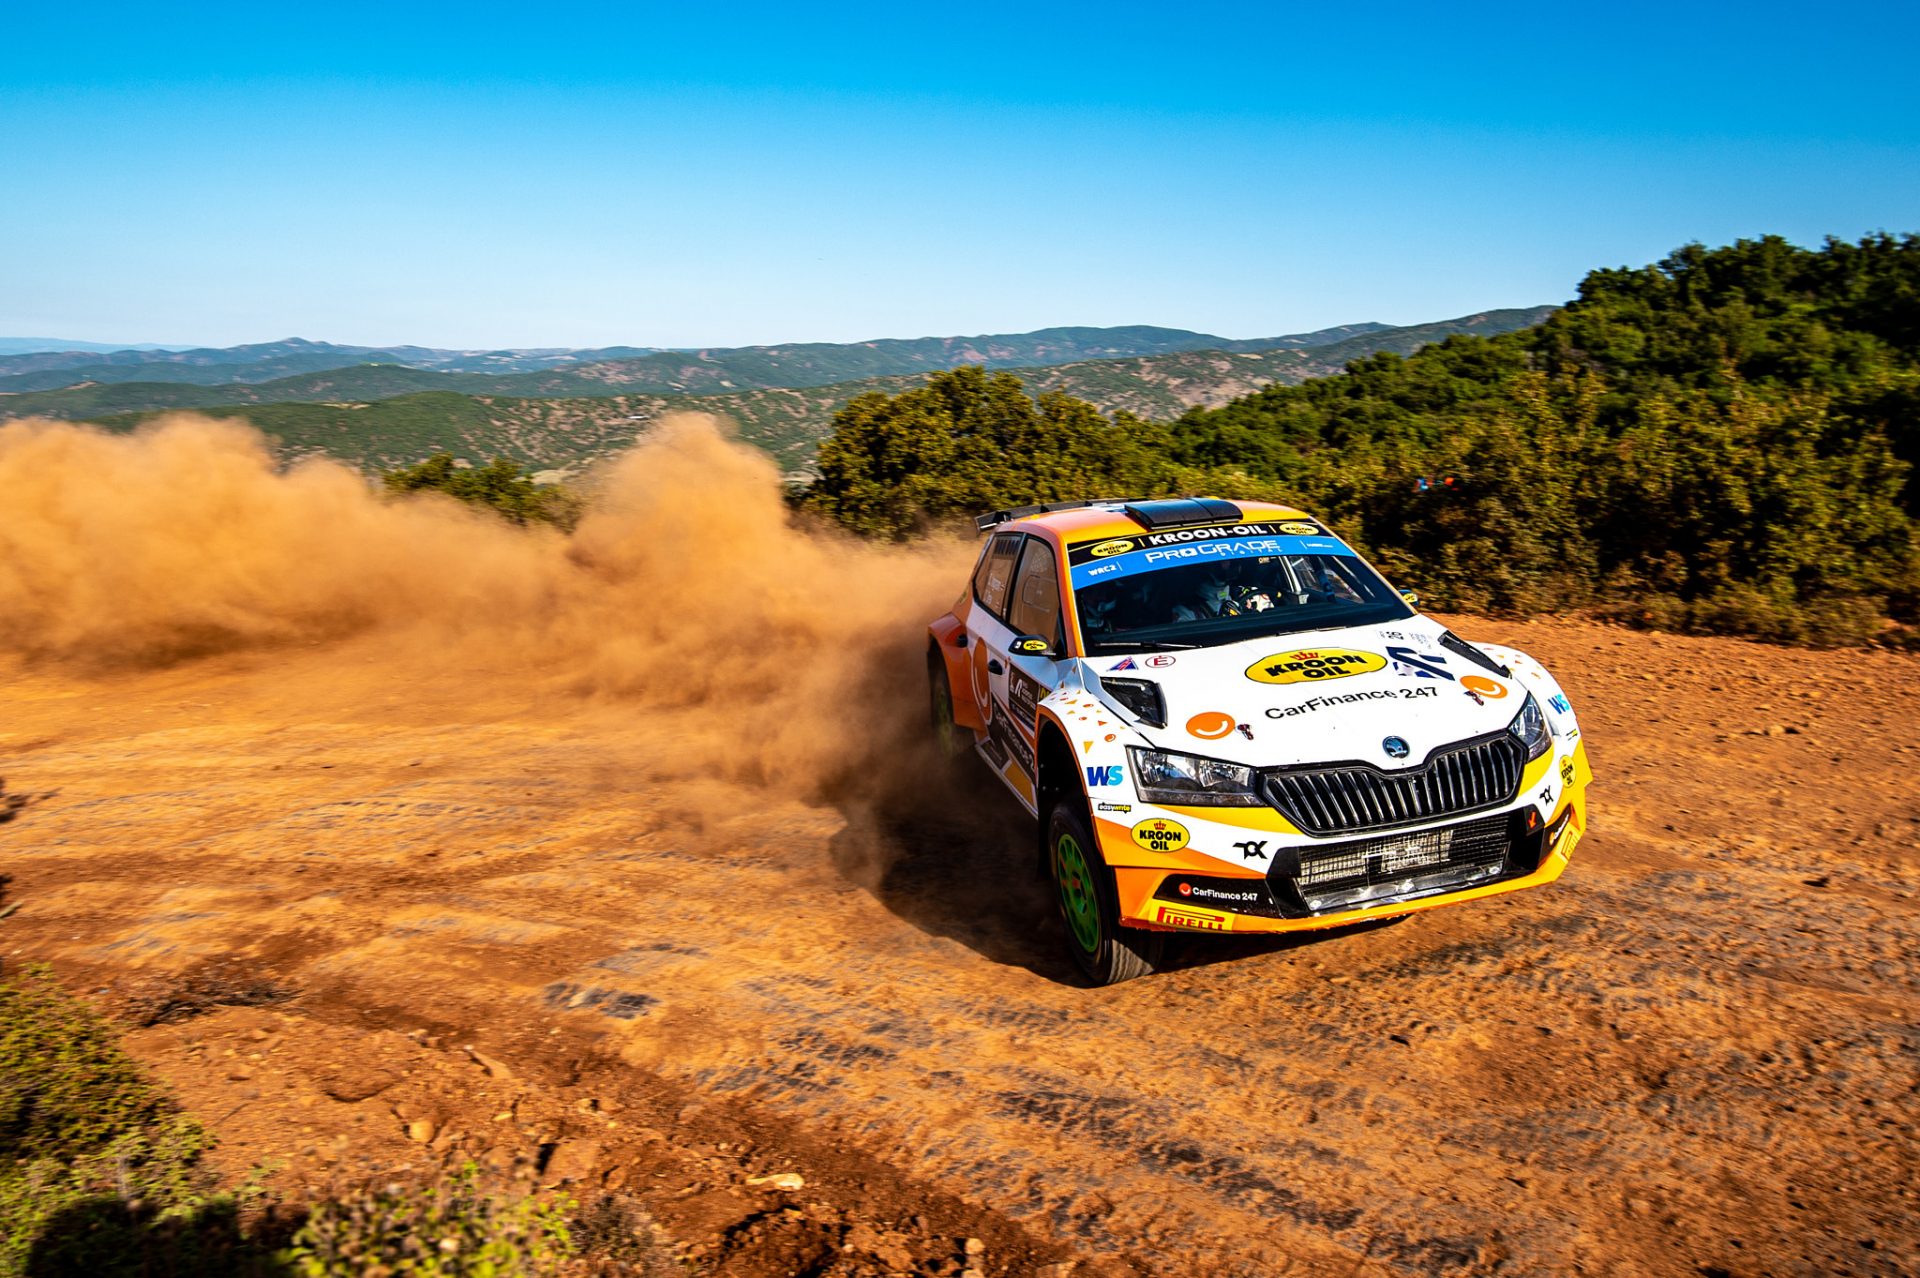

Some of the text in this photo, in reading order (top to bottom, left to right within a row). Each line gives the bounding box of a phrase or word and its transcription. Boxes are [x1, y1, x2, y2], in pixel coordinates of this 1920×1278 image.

[1149, 525, 1268, 546] KROON-OIL
[1096, 543, 1128, 553] KROON
[1087, 564, 1117, 577] WRC2
[1264, 654, 1368, 677] KROON
[1302, 664, 1353, 679] OIL
[1264, 686, 1439, 719] CarFinance 247
[1086, 765, 1123, 787] WS
[1139, 829, 1182, 842] KROON
[1150, 840, 1169, 851] OIL
[1192, 887, 1258, 901] CarFinance 247
[1156, 906, 1226, 931] PIRELLI
